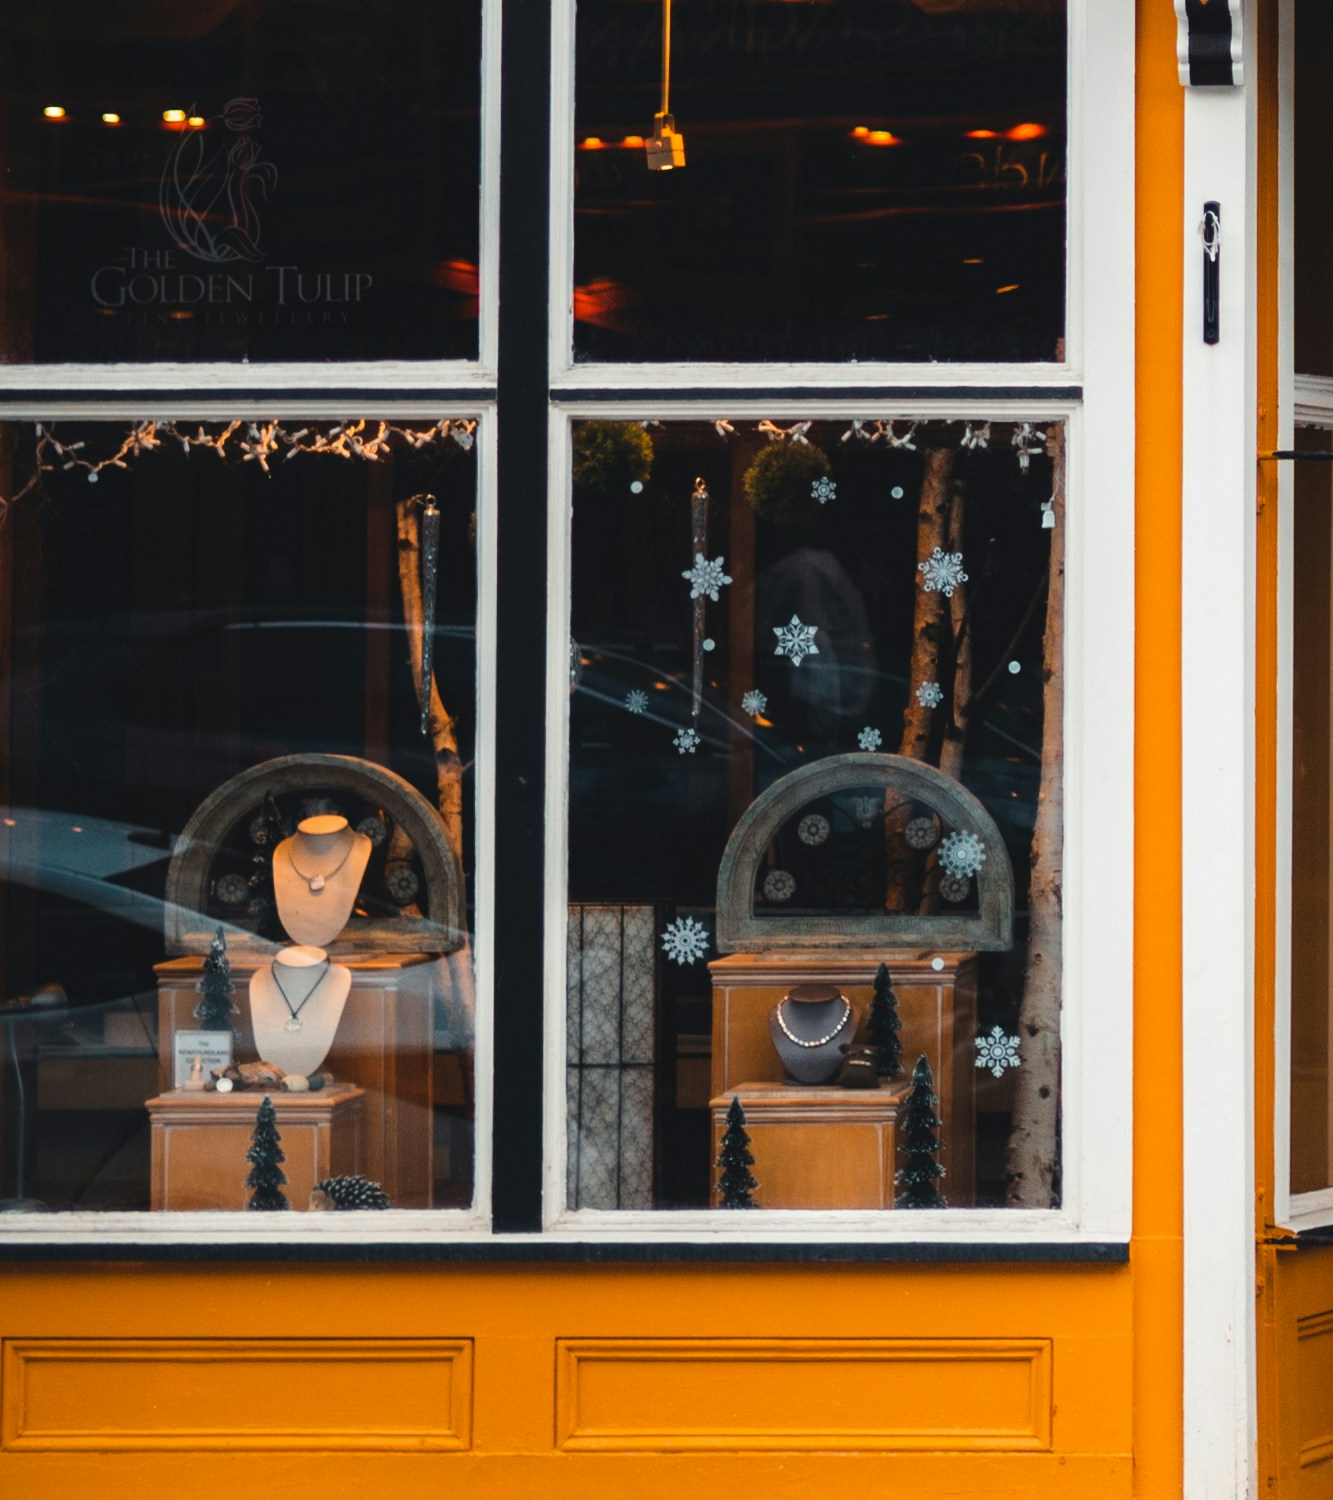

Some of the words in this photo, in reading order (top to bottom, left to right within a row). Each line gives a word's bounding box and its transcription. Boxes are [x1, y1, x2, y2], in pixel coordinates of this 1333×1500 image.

[124, 247, 176, 269] THE
[91, 266, 254, 308] GOLDEN
[266, 264, 374, 305] TULIP
